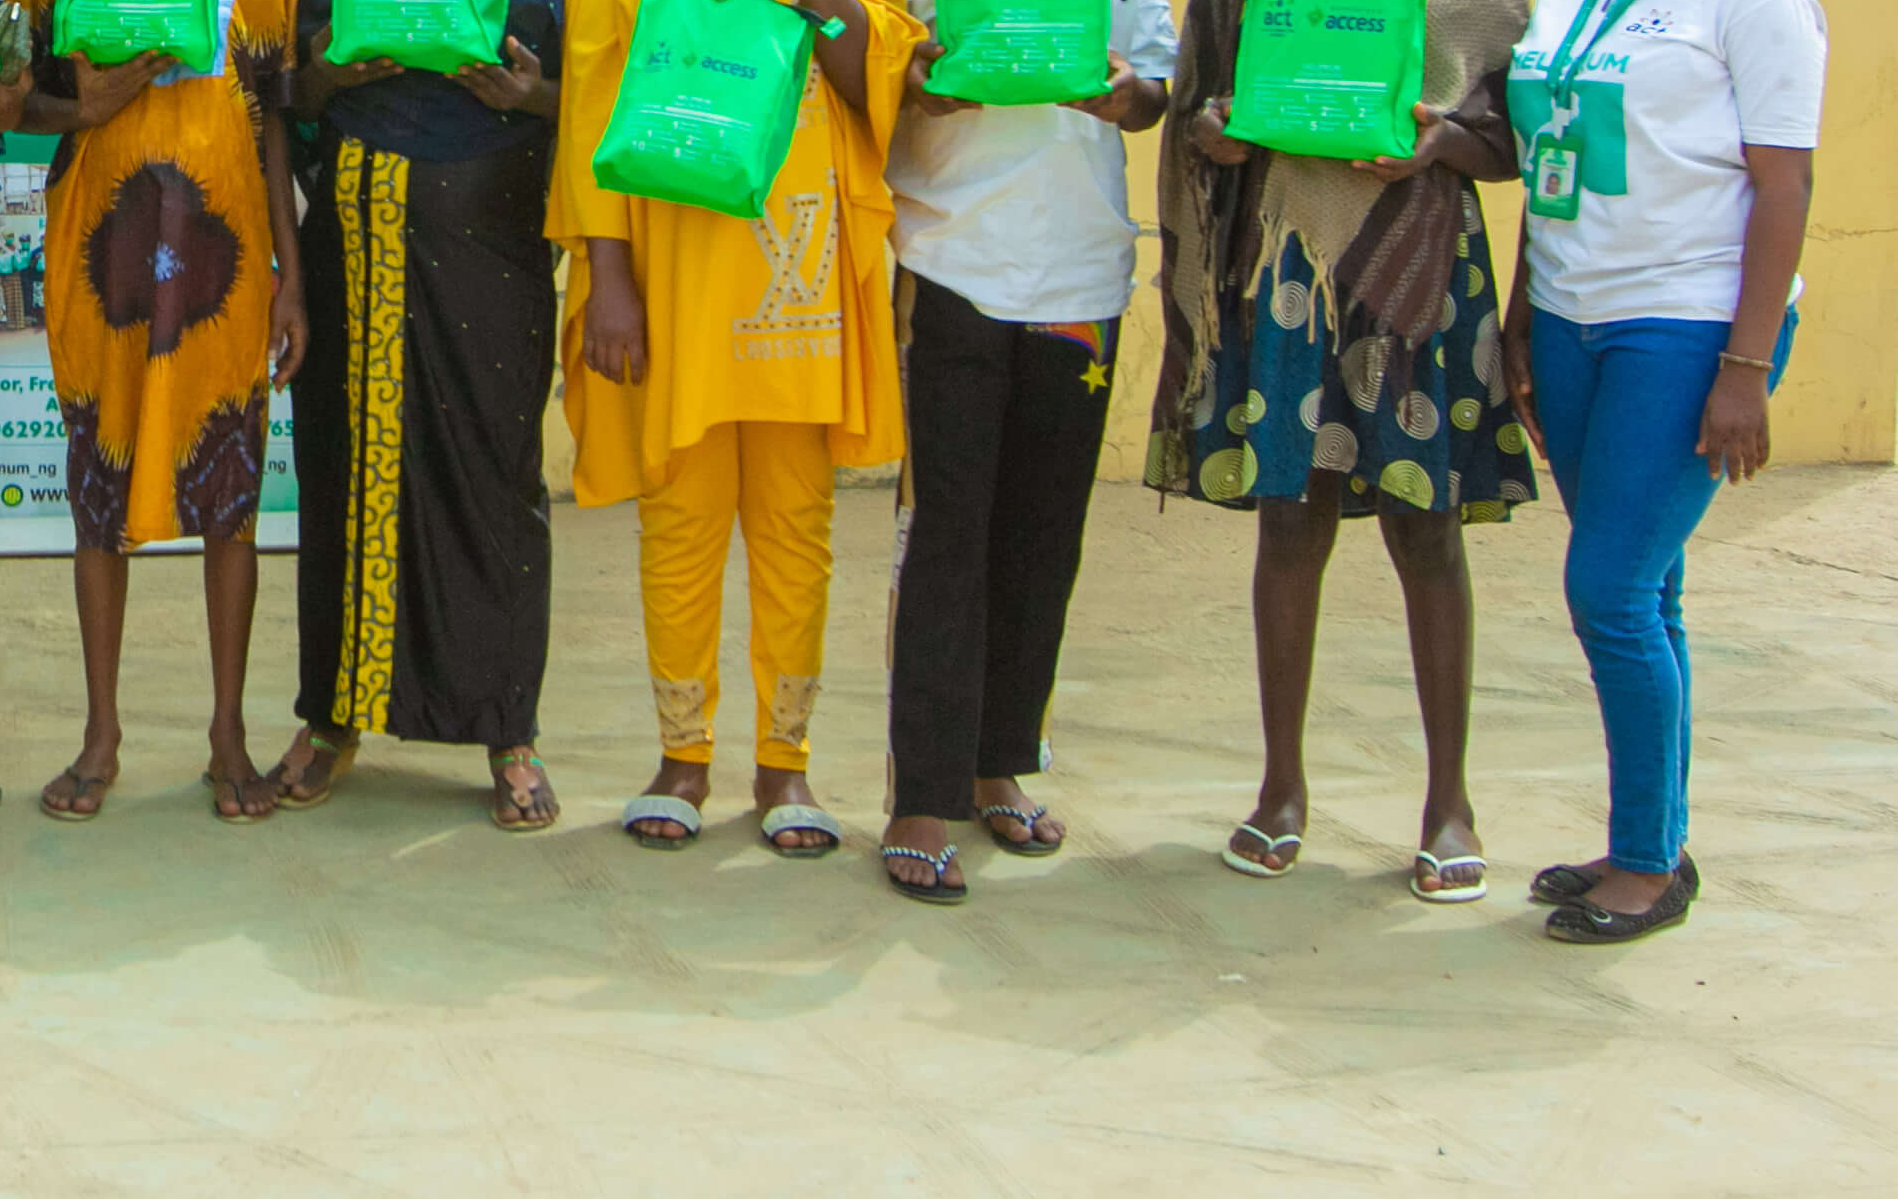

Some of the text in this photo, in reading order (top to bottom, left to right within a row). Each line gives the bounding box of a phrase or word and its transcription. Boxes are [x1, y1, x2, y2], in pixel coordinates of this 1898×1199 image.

[1263, 7, 1294, 28] act
[1325, 15, 1387, 34] access
[702, 56, 760, 80] access
